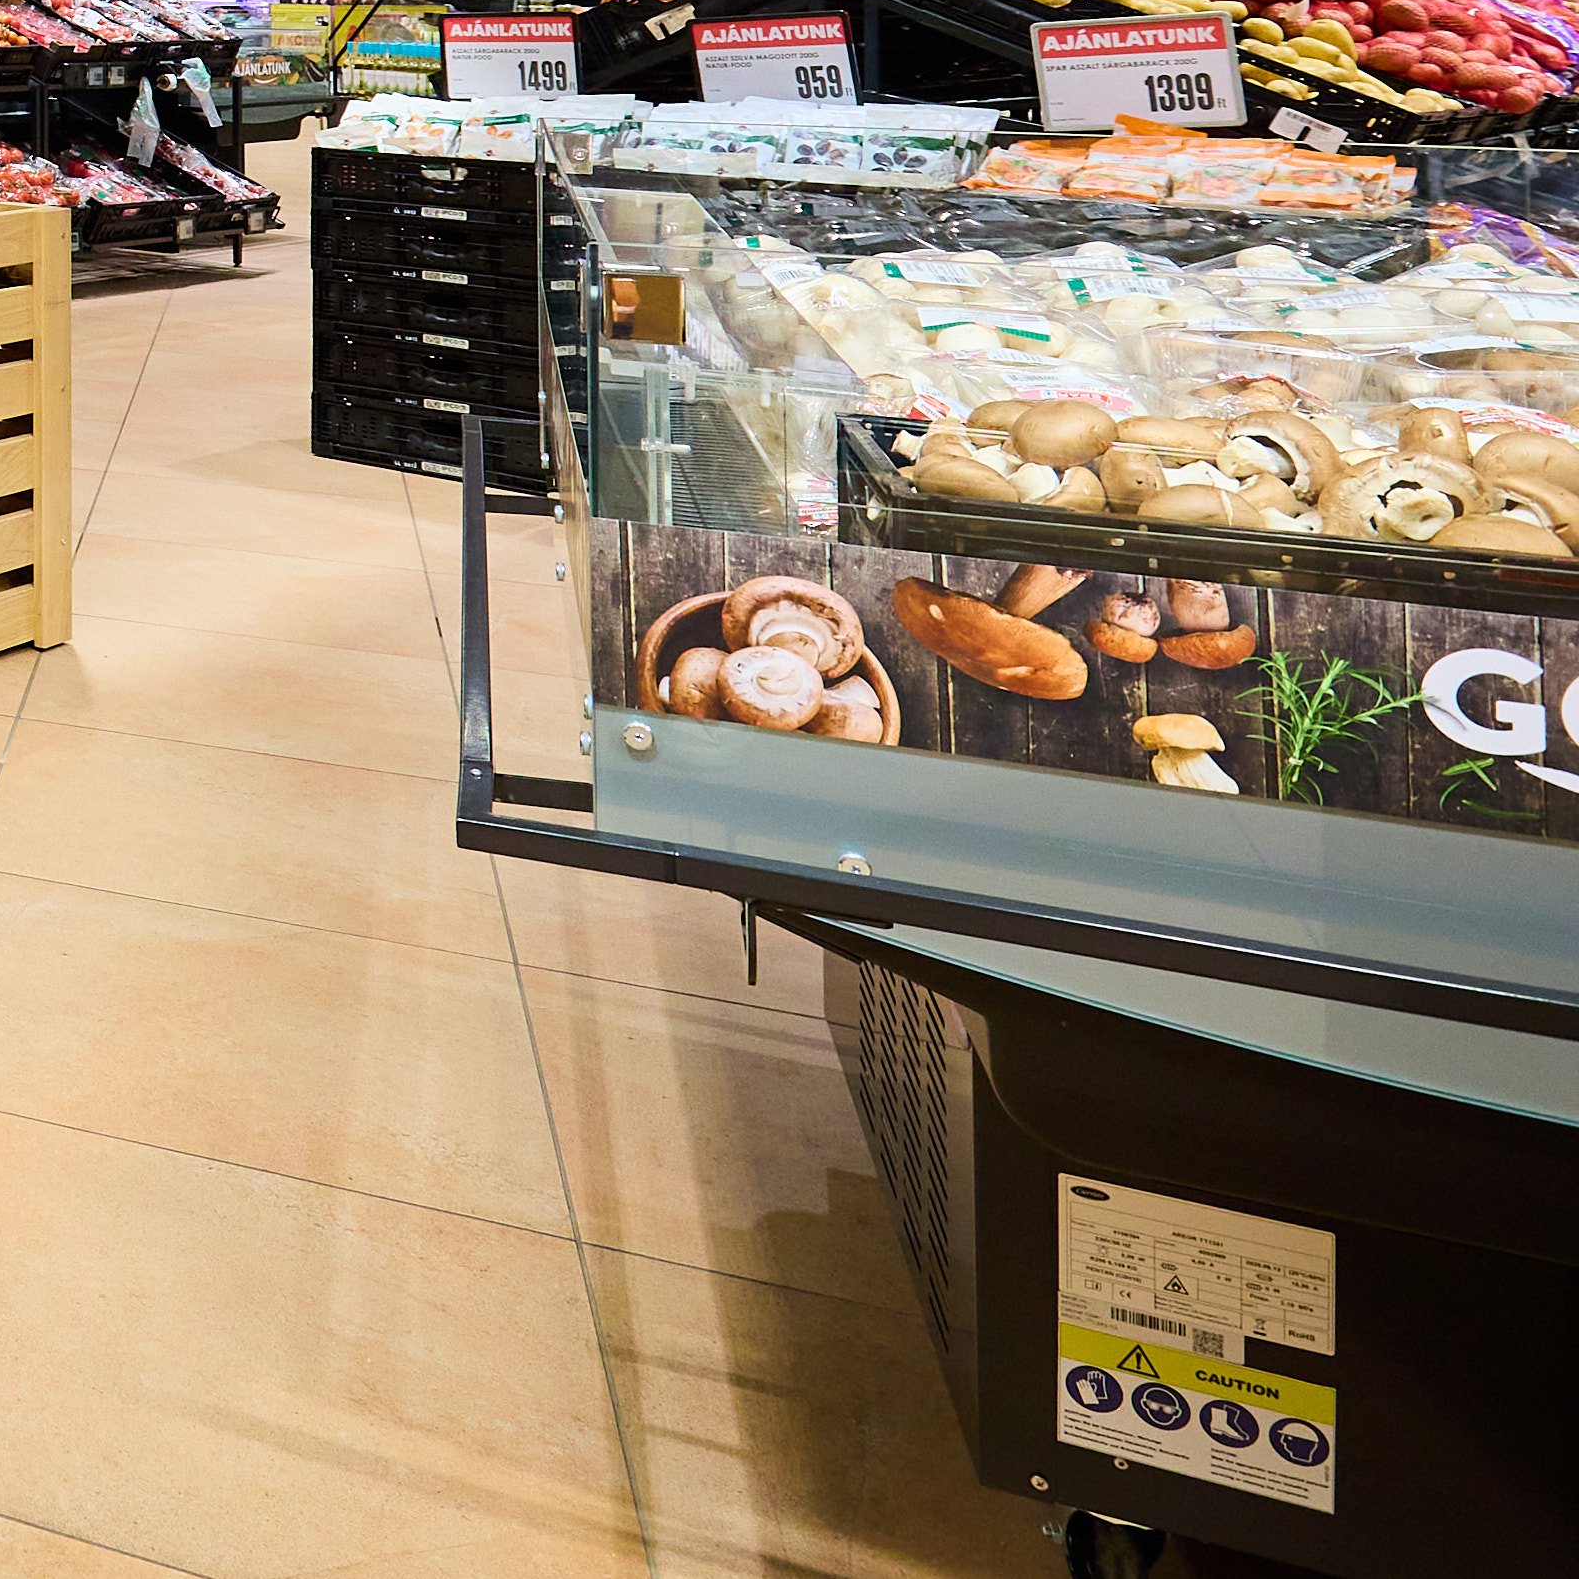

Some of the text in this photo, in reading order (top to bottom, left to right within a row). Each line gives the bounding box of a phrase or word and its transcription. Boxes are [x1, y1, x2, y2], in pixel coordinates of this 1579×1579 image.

[450, 19, 572, 37] AJÁNLATUNK
[701, 23, 844, 44] AJÁNLATUNK
[1043, 25, 1218, 52] AJÁNLATUNK
[234, 58, 291, 77] AJÁNLATUNK
[756, 53, 798, 61] MAGOZOTT
[1070, 63, 1100, 71] ASZALT
[1102, 59, 1171, 70] SÁRGABARACK
[1174, 58, 1198, 66] 200G
[518, 60, 568, 91] 1499
[795, 65, 854, 99] 959 Ft
[1144, 73, 1214, 112] 1399
[1422, 648, 1579, 756] G
[1195, 1369, 1280, 1400] CAUTION
